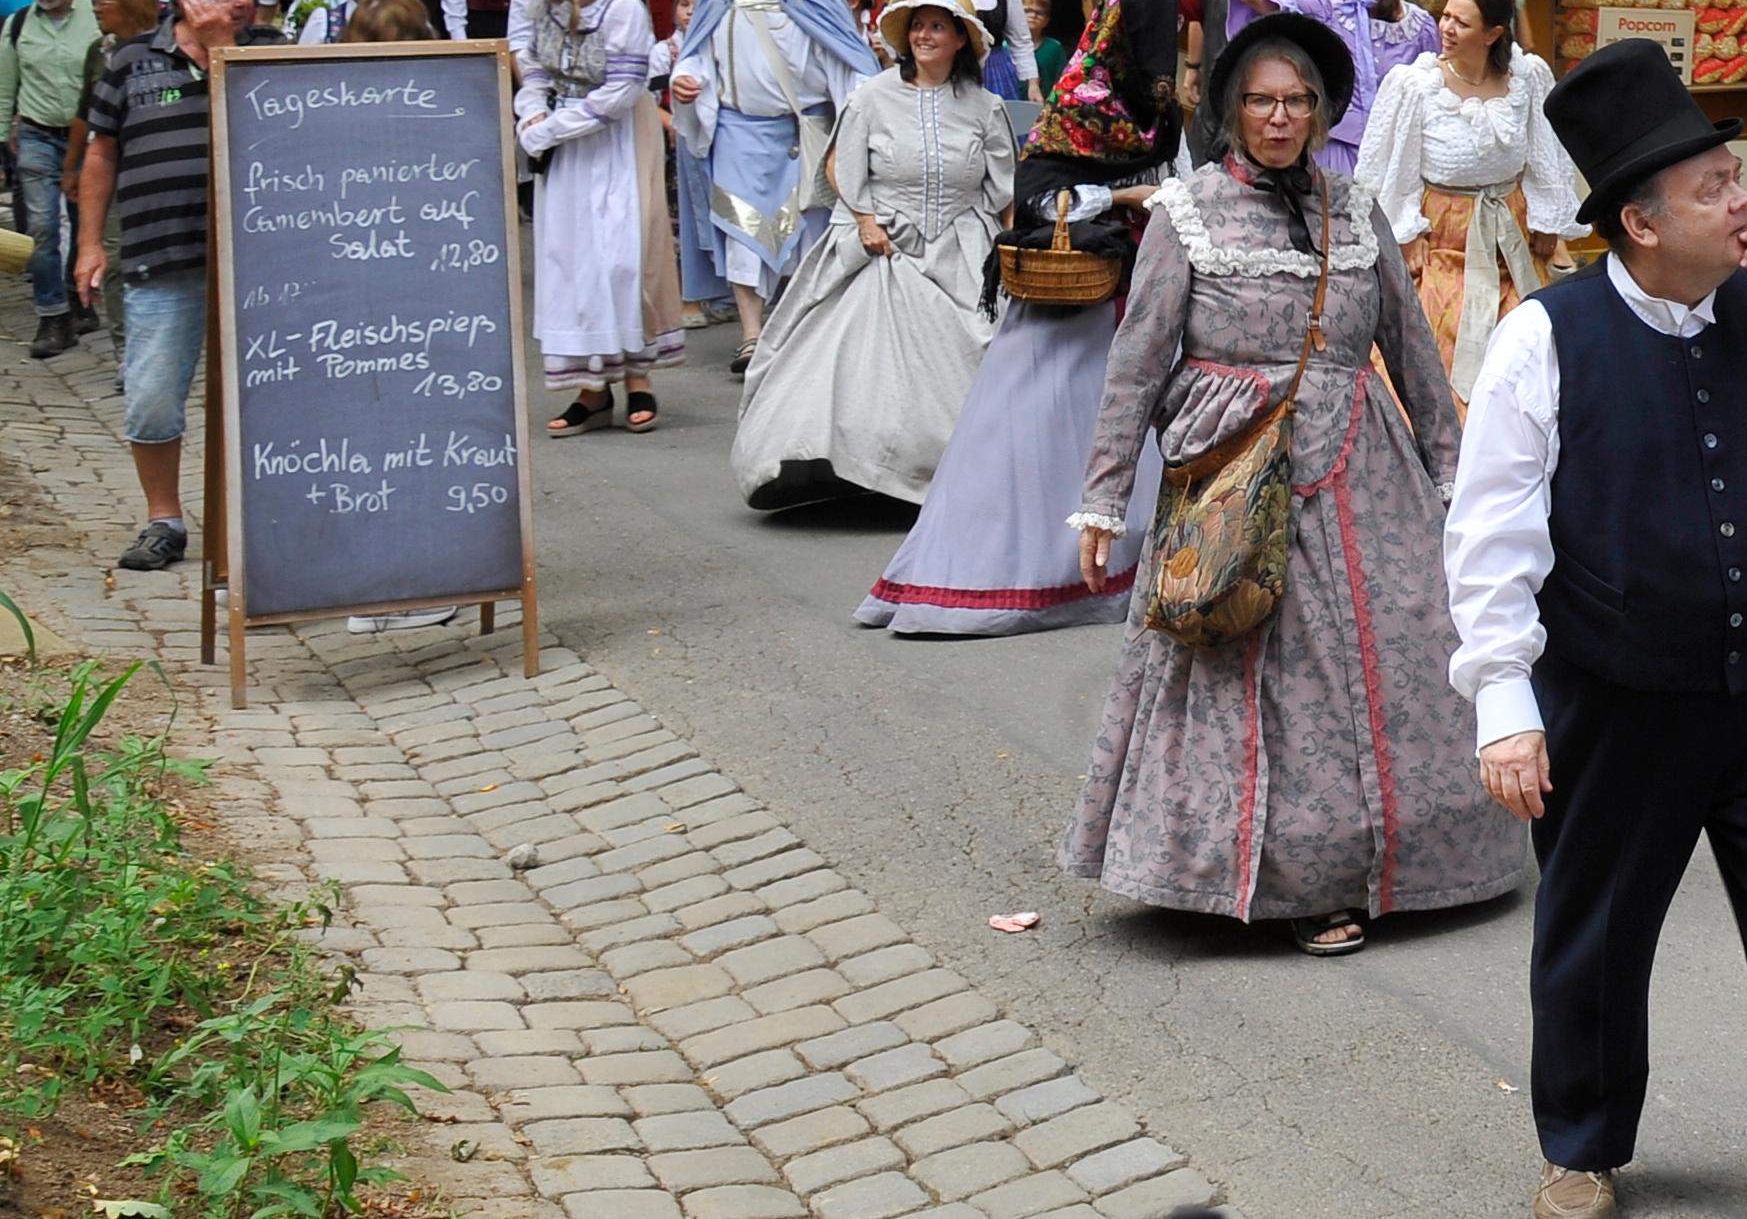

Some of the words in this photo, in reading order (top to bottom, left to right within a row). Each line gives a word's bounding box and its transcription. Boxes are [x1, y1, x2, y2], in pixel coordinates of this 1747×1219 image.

[1618, 17, 1676, 34] Popcorn
[246, 79, 438, 129] Tageskarte
[243, 162, 324, 205] frisch
[341, 153, 480, 199] panierter
[243, 196, 406, 233] Camembert
[420, 190, 480, 229] auf
[329, 230, 415, 259] Salat
[246, 356, 300, 387] mit
[316, 351, 430, 378] Pommes
[413, 371, 503, 399] 13,80
[254, 439, 372, 480] Knöchla
[383, 432, 433, 472] mit
[443, 431, 517, 468] Kraut
[329, 479, 397, 513] Brot
[445, 483, 508, 513] 9,50
